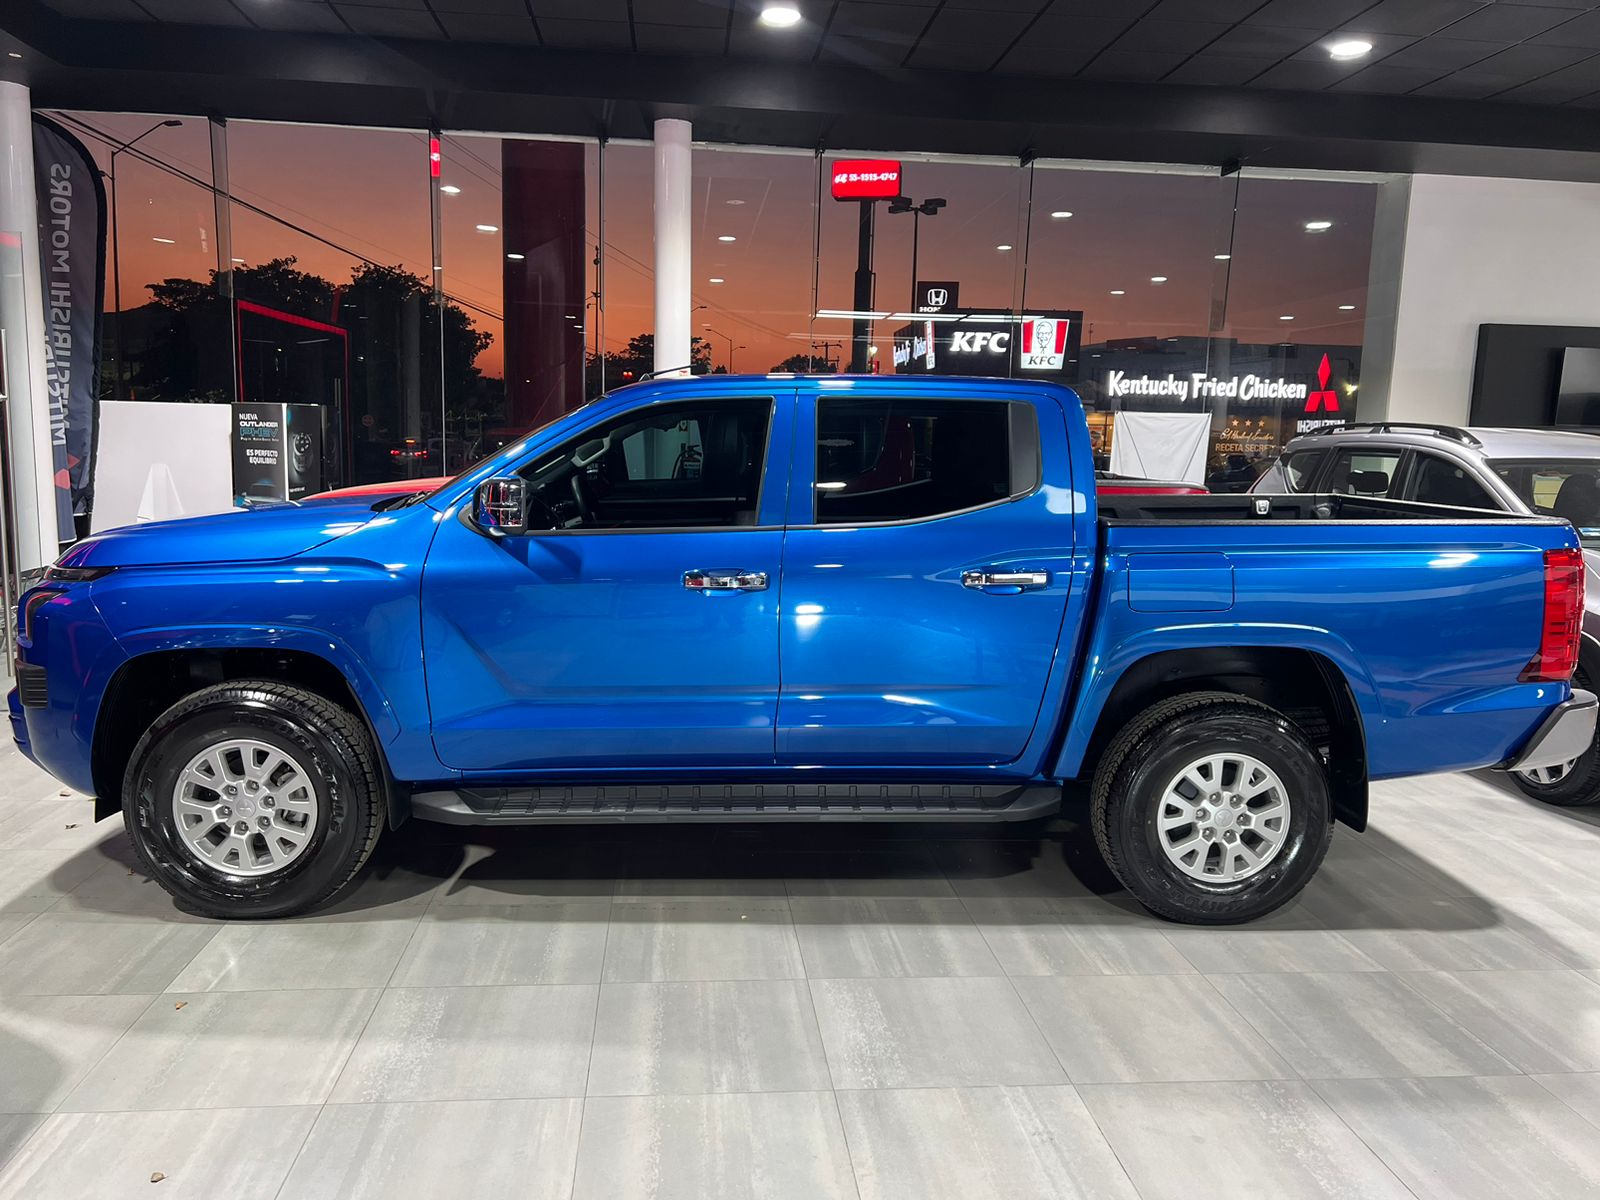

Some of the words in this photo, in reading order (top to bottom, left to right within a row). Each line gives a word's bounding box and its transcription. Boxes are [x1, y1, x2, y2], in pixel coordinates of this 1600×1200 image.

[950, 331, 1010, 352] KFC
[1028, 355, 1057, 365] KFC
[1108, 370, 1188, 402] Kentucky
[1192, 373, 1238, 399] Fried
[1240, 374, 1307, 401] Chicken
[238, 413, 258, 421] NUEVA
[1215, 443, 1244, 452] RECETA
[1245, 443, 1276, 452] SECRE
[255, 449, 279, 457] PERFECTO
